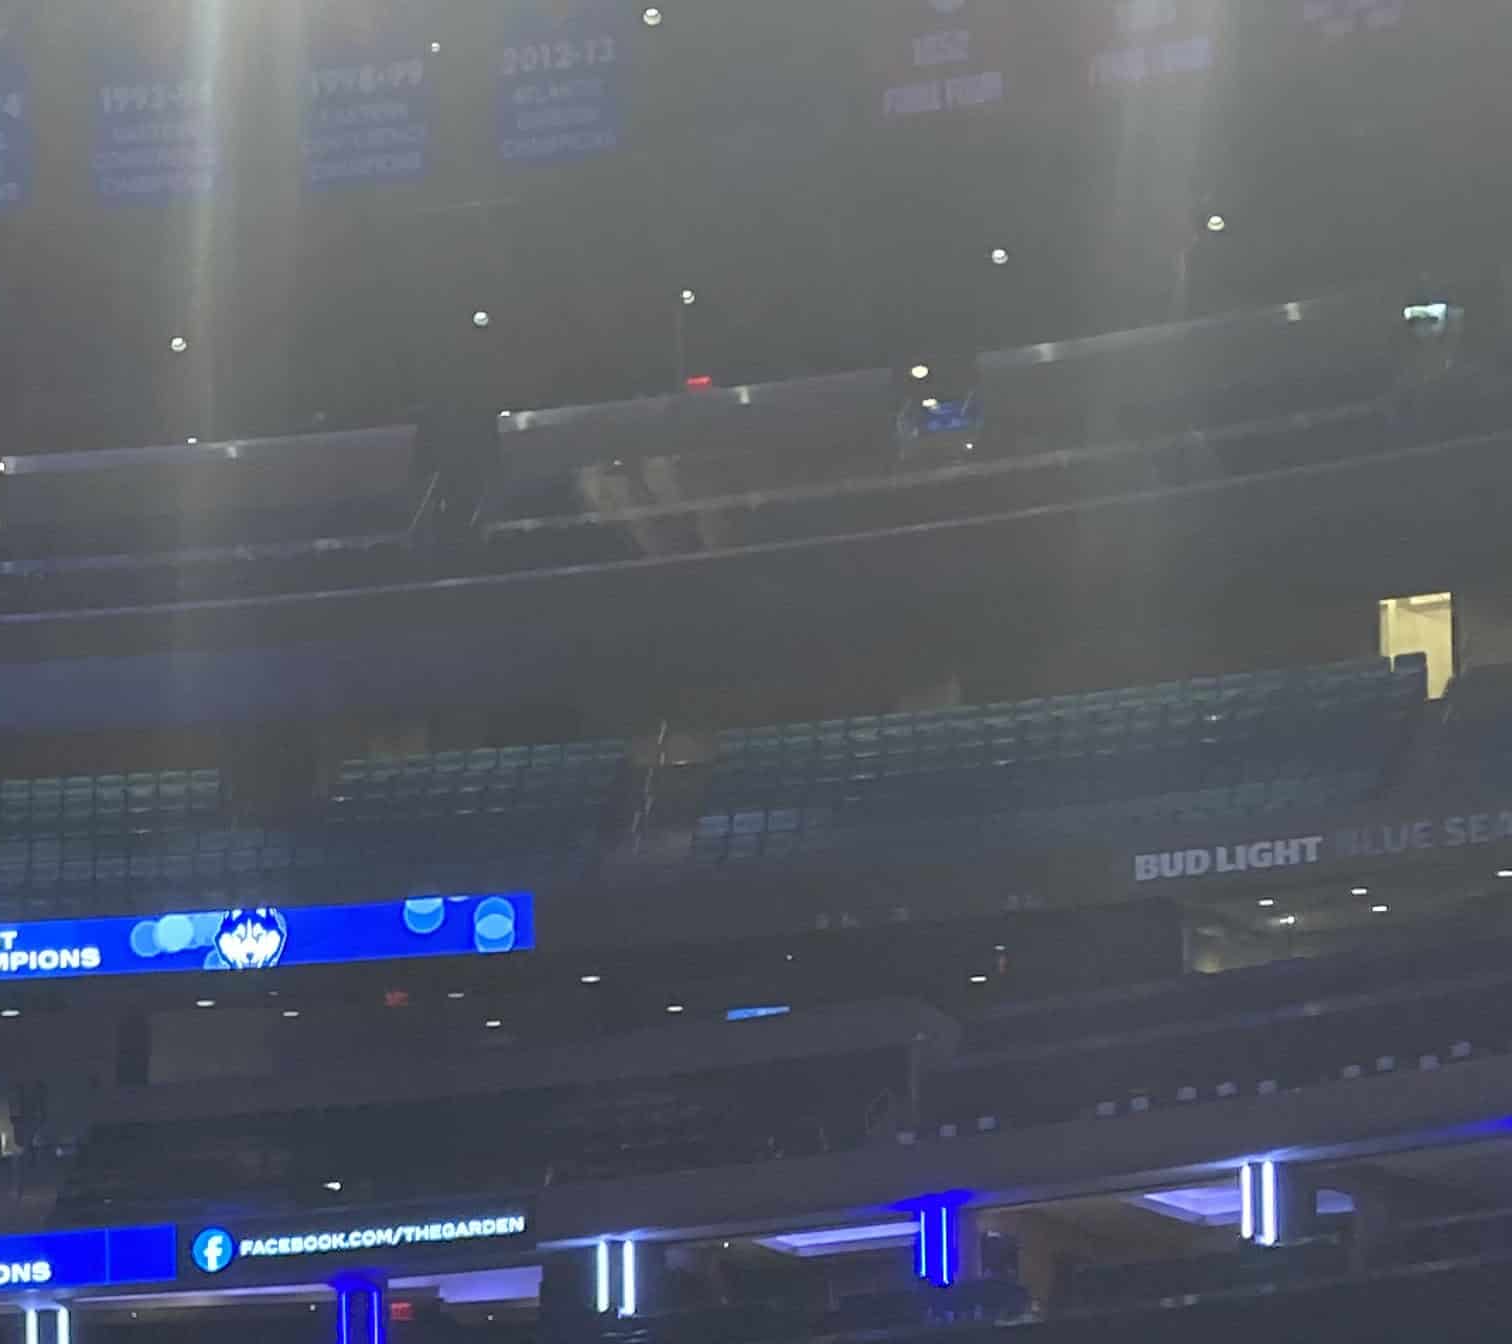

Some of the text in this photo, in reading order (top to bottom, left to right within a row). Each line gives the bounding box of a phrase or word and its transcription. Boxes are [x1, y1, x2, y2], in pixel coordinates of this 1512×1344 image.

[1135, 848, 1210, 881] BUD
[1217, 836, 1324, 872] LIGHT
[239, 1216, 525, 1257] FACEBOOK.COM/THEGARDEN
